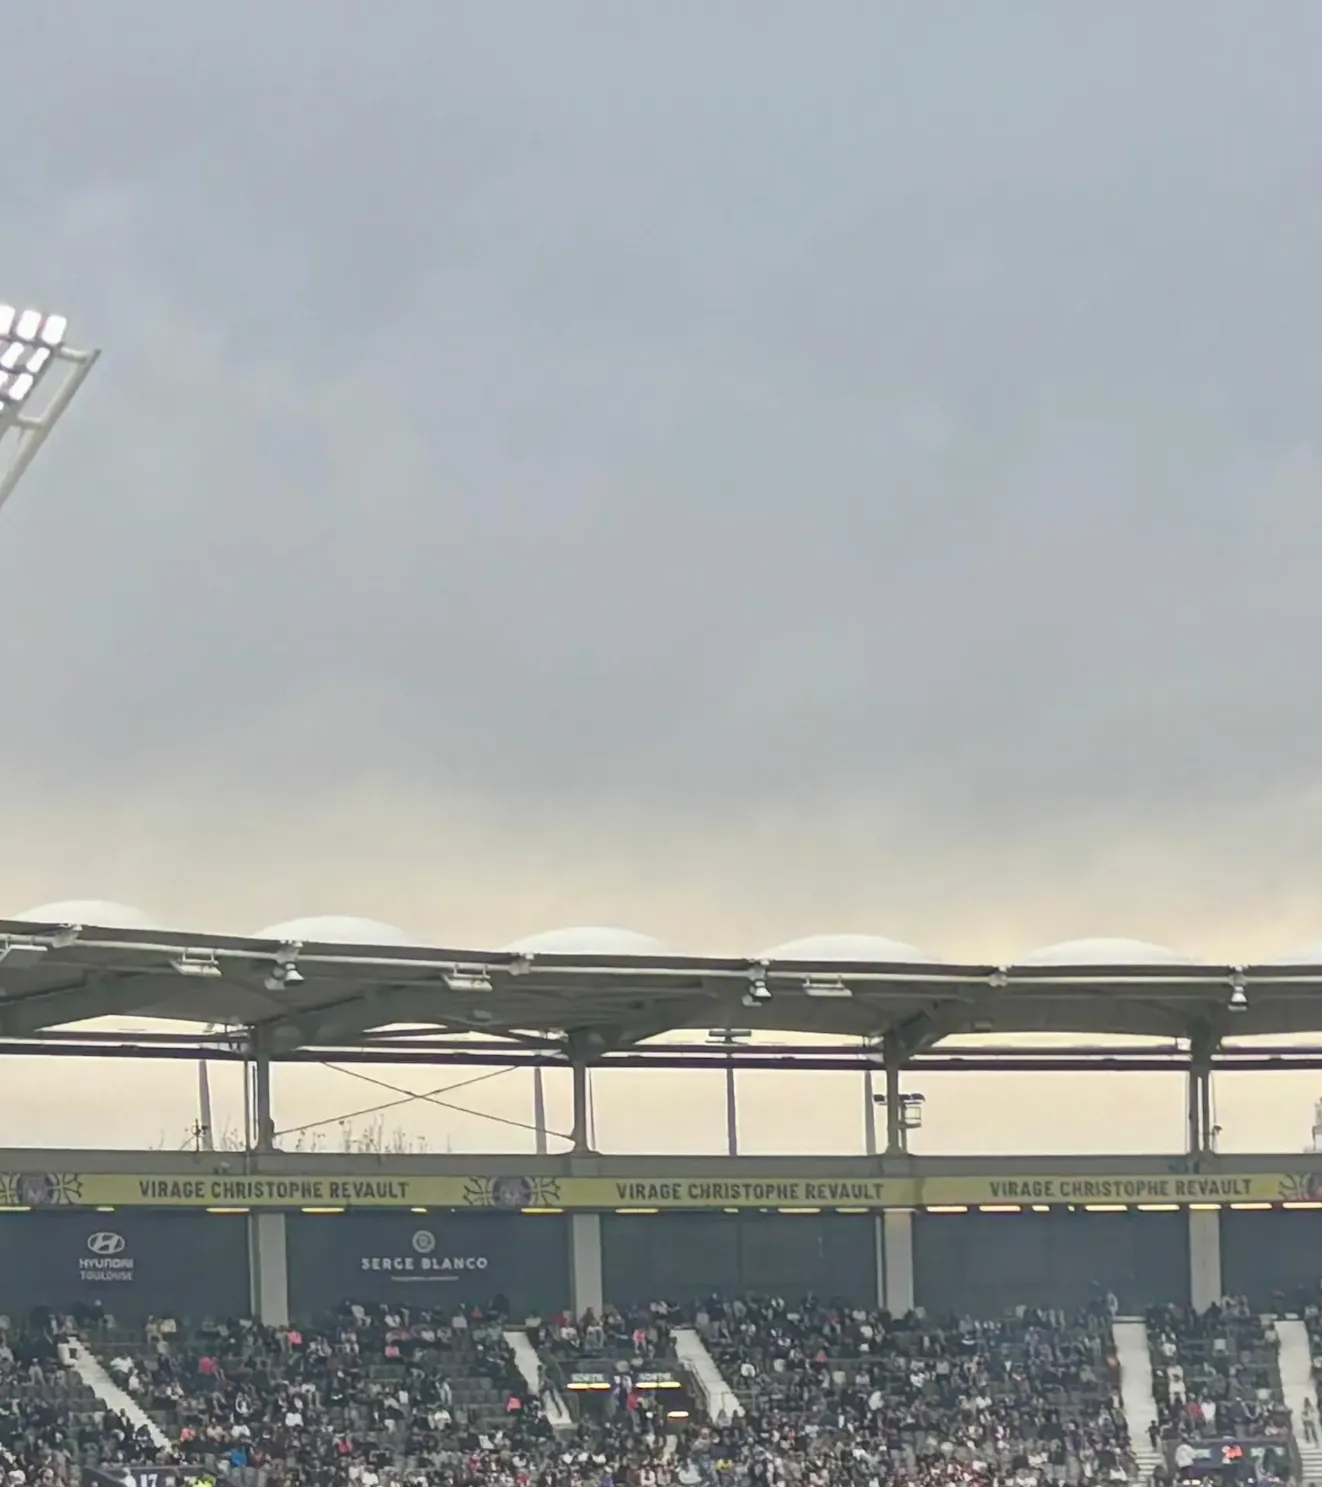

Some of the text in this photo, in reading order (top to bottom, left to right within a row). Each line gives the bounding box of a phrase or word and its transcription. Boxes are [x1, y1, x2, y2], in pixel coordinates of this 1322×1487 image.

[139, 1180, 409, 1199] VIRAGE CHRISTOPHE REVAULT
[616, 1183, 884, 1200] VIRAGE CHRISTOPHE REVAULT
[990, 1178, 1252, 1198] VIRAGE CHRISTOPHE REVAULT
[79, 1258, 133, 1269] HYUNDAI
[361, 1256, 488, 1270] SERGE BLANCO
[80, 1270, 133, 1281] TOULOUSE
